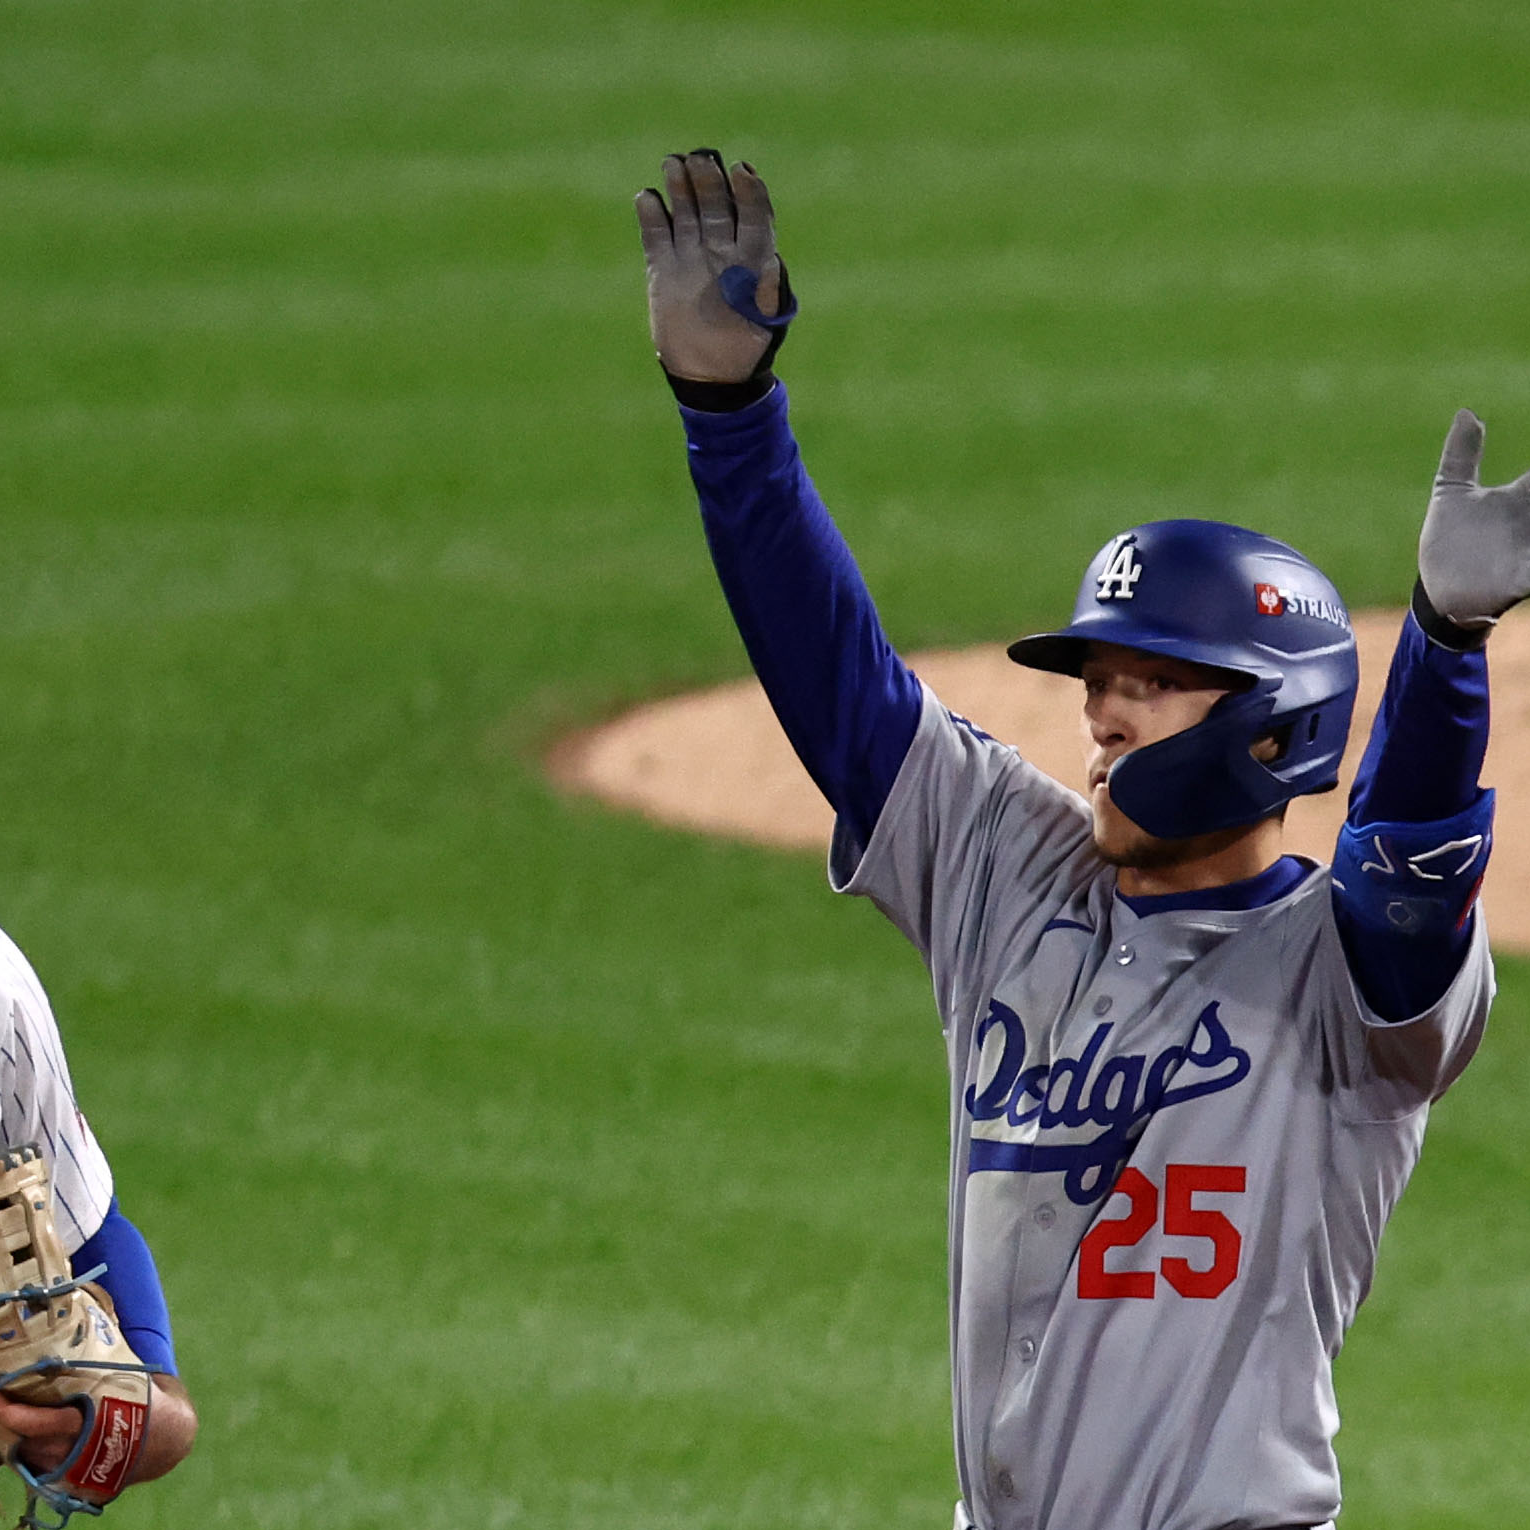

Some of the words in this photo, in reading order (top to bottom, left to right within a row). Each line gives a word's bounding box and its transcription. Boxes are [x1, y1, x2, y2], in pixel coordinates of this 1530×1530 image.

[1096, 533, 1143, 599] LA
[1285, 591, 1353, 634] STRAUS
[1077, 1164, 1246, 1299] 25
